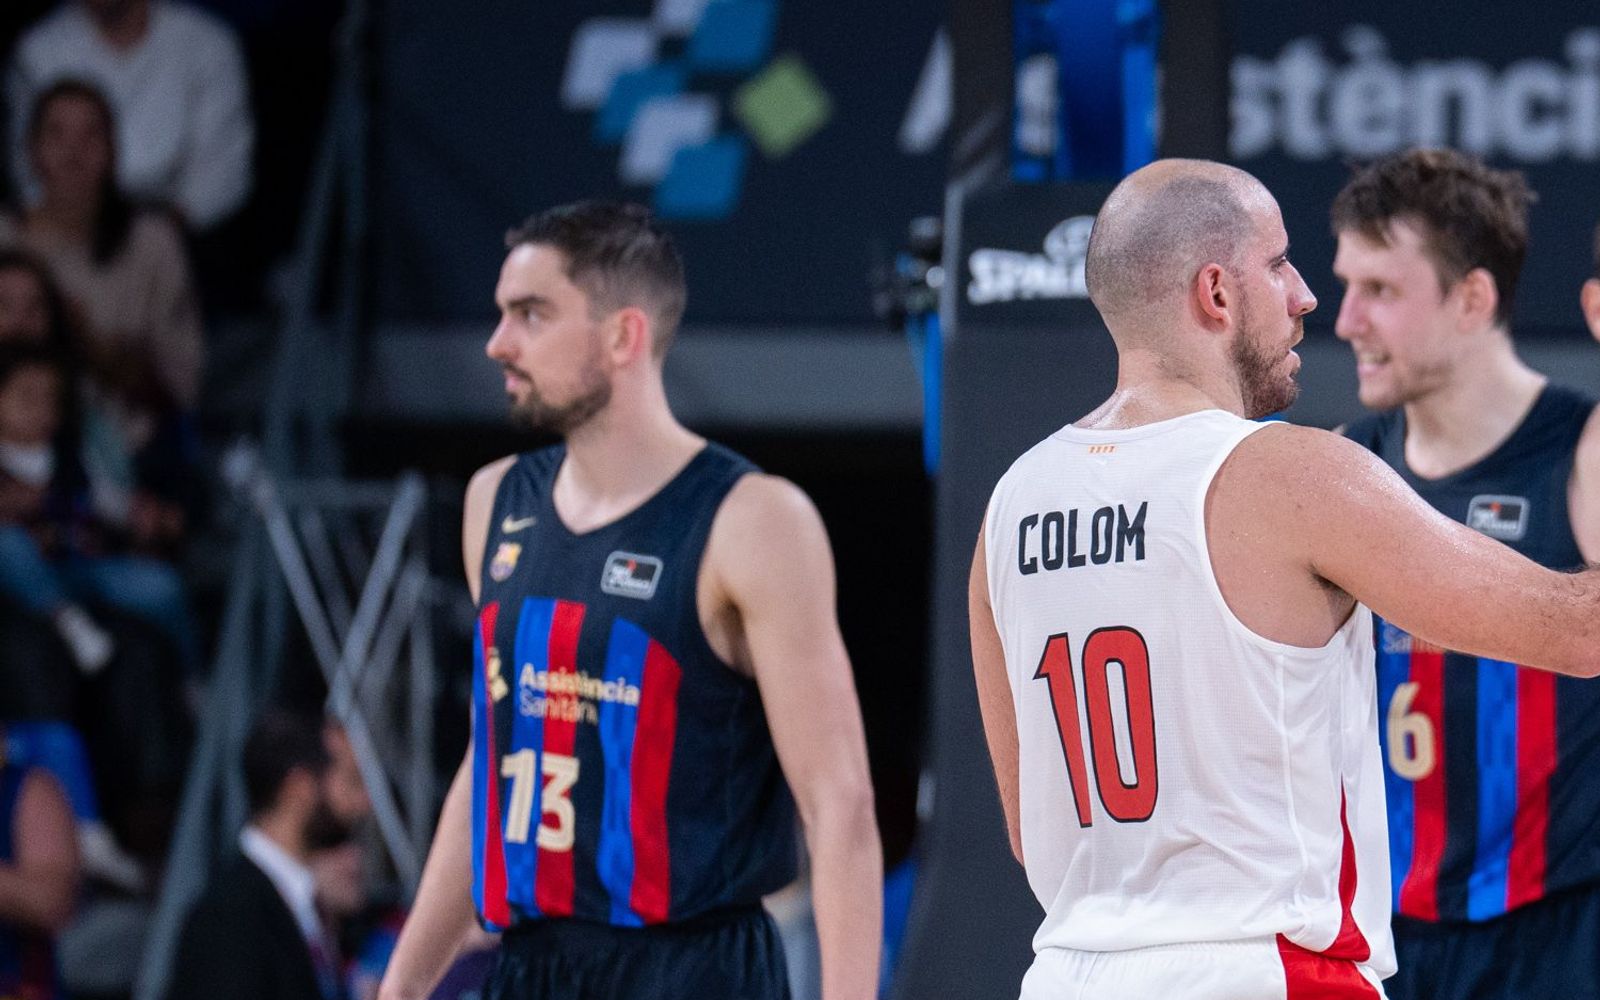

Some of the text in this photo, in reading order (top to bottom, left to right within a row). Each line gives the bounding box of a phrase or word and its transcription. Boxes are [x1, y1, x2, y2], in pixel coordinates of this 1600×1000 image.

[1018, 501, 1148, 575] COLOM
[518, 663, 640, 707] Assistència
[1032, 625, 1158, 828] 10
[1387, 681, 1436, 781] 6
[501, 748, 580, 853] 13
